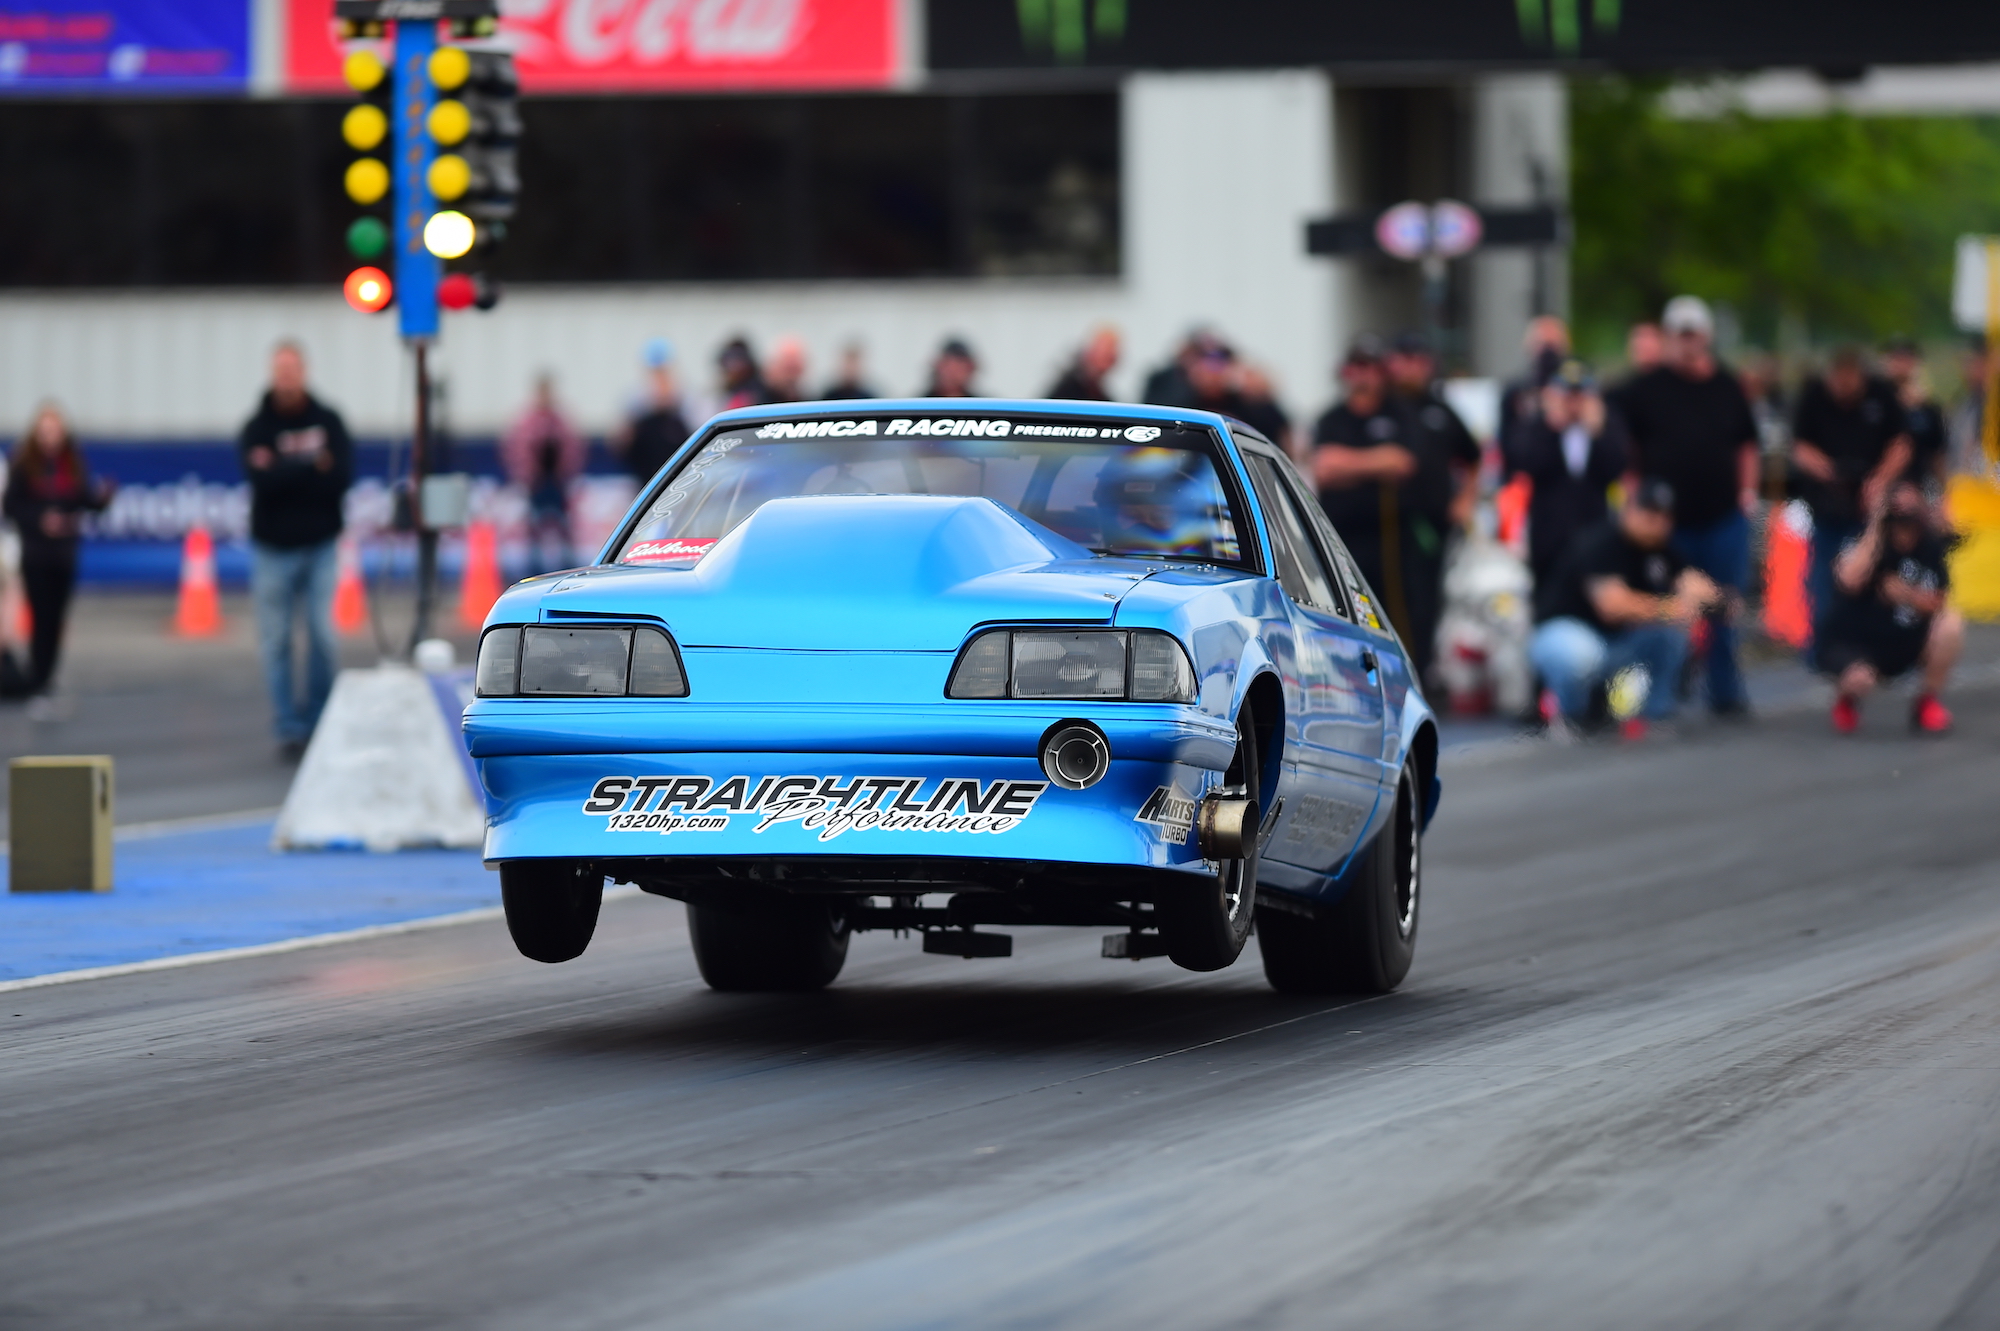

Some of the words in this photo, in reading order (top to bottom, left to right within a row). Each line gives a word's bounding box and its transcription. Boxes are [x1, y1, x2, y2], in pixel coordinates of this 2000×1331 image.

[772, 420, 878, 439] NMCA
[884, 418, 1012, 437] RACING
[1013, 425, 1098, 438] PRESENTED
[1099, 428, 1122, 438] BY
[584, 775, 1050, 815] STRAIGHTLINE
[1137, 787, 1195, 822] HARTS
[607, 812, 728, 832] 1320hp.com
[755, 797, 1016, 840] Performance
[1161, 822, 1188, 843] TURBO
